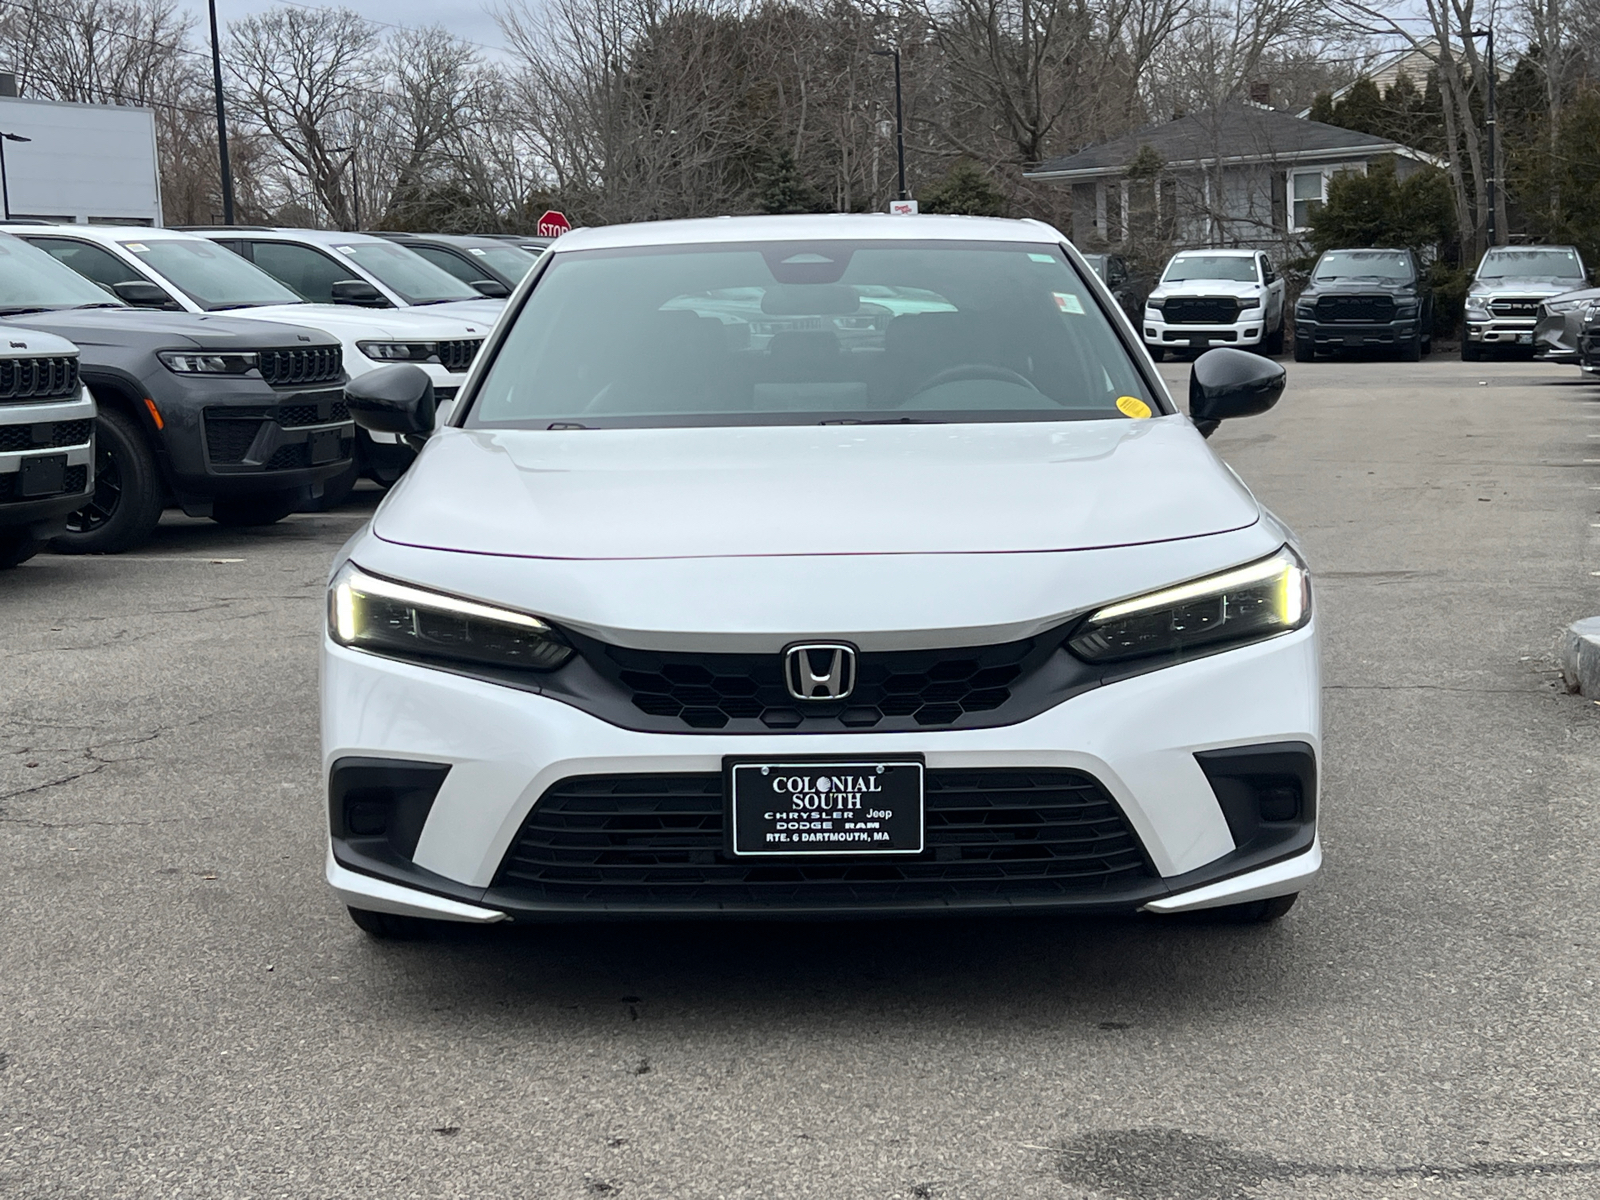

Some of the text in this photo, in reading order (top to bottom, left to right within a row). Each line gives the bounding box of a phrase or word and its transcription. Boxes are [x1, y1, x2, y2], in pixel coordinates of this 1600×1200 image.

[772, 775, 882, 793] COLONIAL
[792, 793, 862, 810] SOUTH
[764, 808, 892, 820] CHRYSLER Jeep
[776, 821, 833, 830] DODGE
[766, 832, 890, 843] RTE. 6 DARTMOUTH, MA
